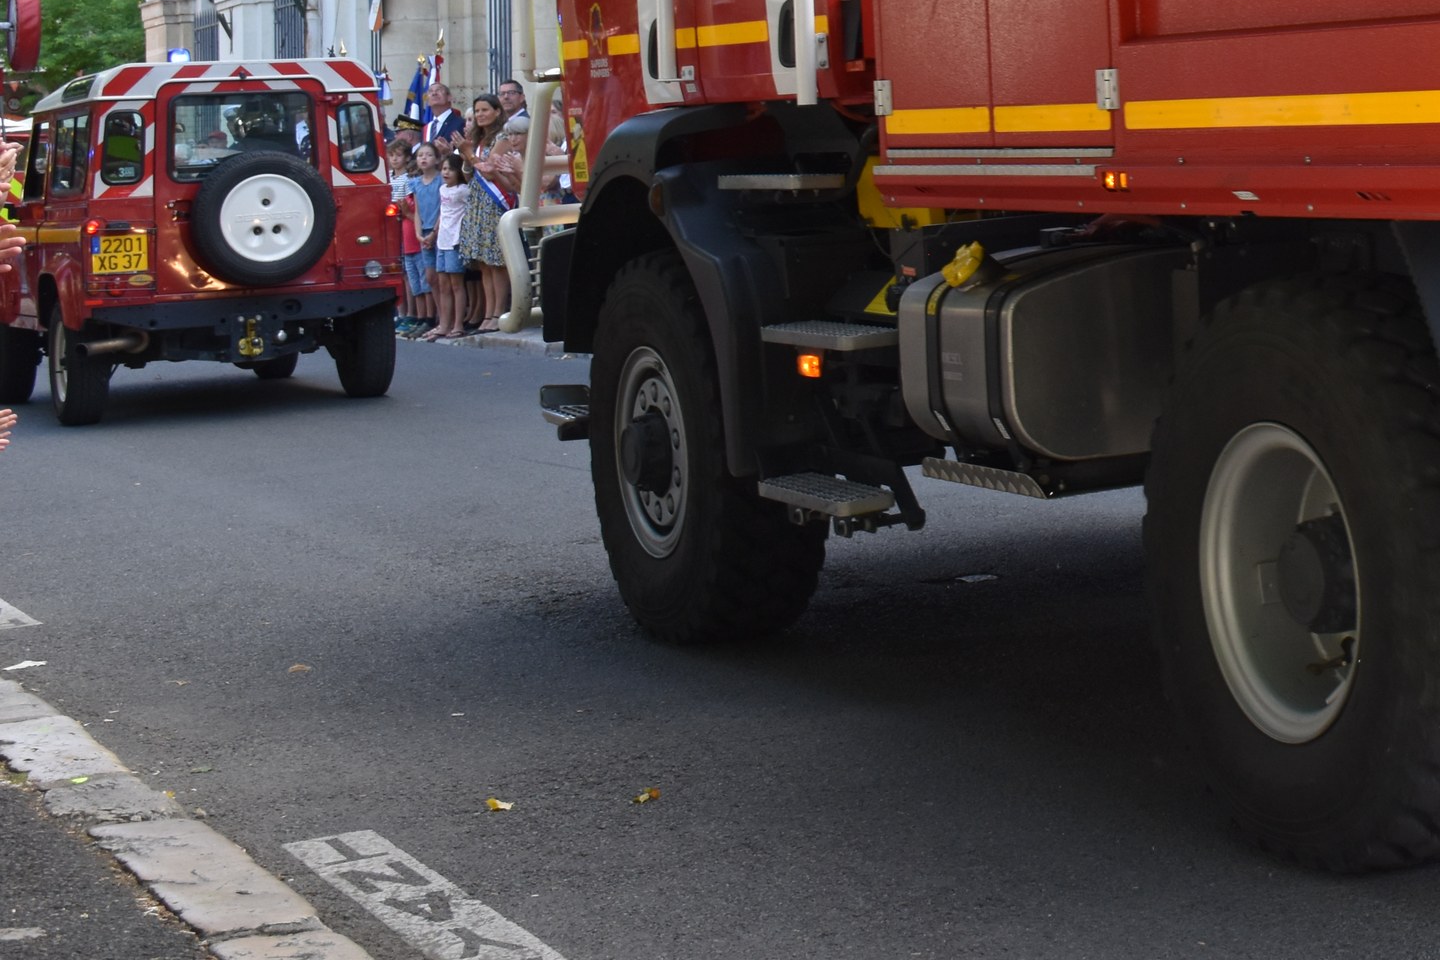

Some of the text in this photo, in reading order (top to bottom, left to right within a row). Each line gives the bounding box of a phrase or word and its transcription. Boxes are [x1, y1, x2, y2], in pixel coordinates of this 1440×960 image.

[102, 237, 143, 255] 2201
[98, 253, 143, 271] XG 37
